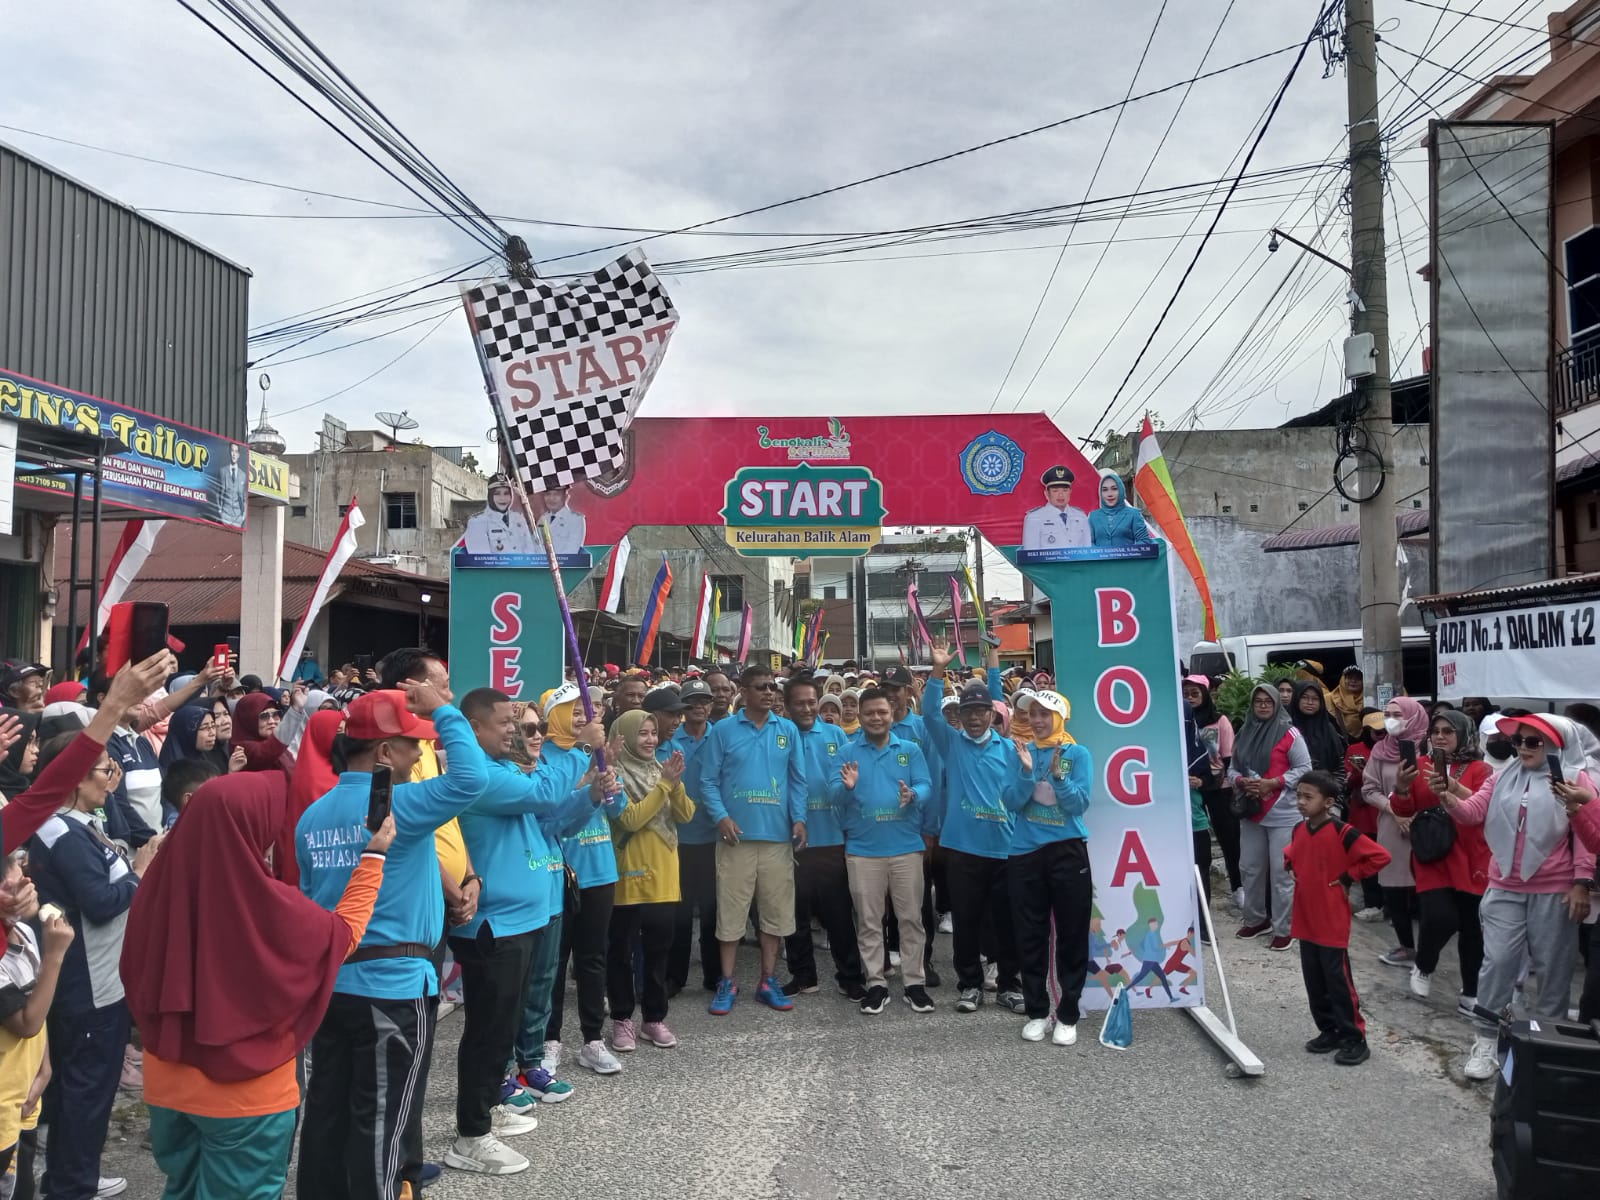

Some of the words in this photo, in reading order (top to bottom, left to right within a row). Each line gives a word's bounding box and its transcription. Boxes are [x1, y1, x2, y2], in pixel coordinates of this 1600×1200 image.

[111, 415, 208, 470] Tailor
[102, 469, 142, 487] PERUSAHAAN
[142, 478, 162, 491] PARTAI
[163, 484, 180, 495] BESAR
[180, 488, 193, 498] DAN
[112, 458, 127, 469] PRIA
[128, 462, 141, 474] DAN
[141, 465, 165, 479] WANITA
[740, 480, 869, 517] START
[736, 531, 800, 543] Kelurahan
[804, 531, 836, 543] Balik
[839, 531, 871, 543] Alam
[1439, 620, 1467, 654] ADA
[1471, 616, 1503, 652] No.1
[1506, 610, 1566, 650] DALAM
[1570, 606, 1596, 646] 12
